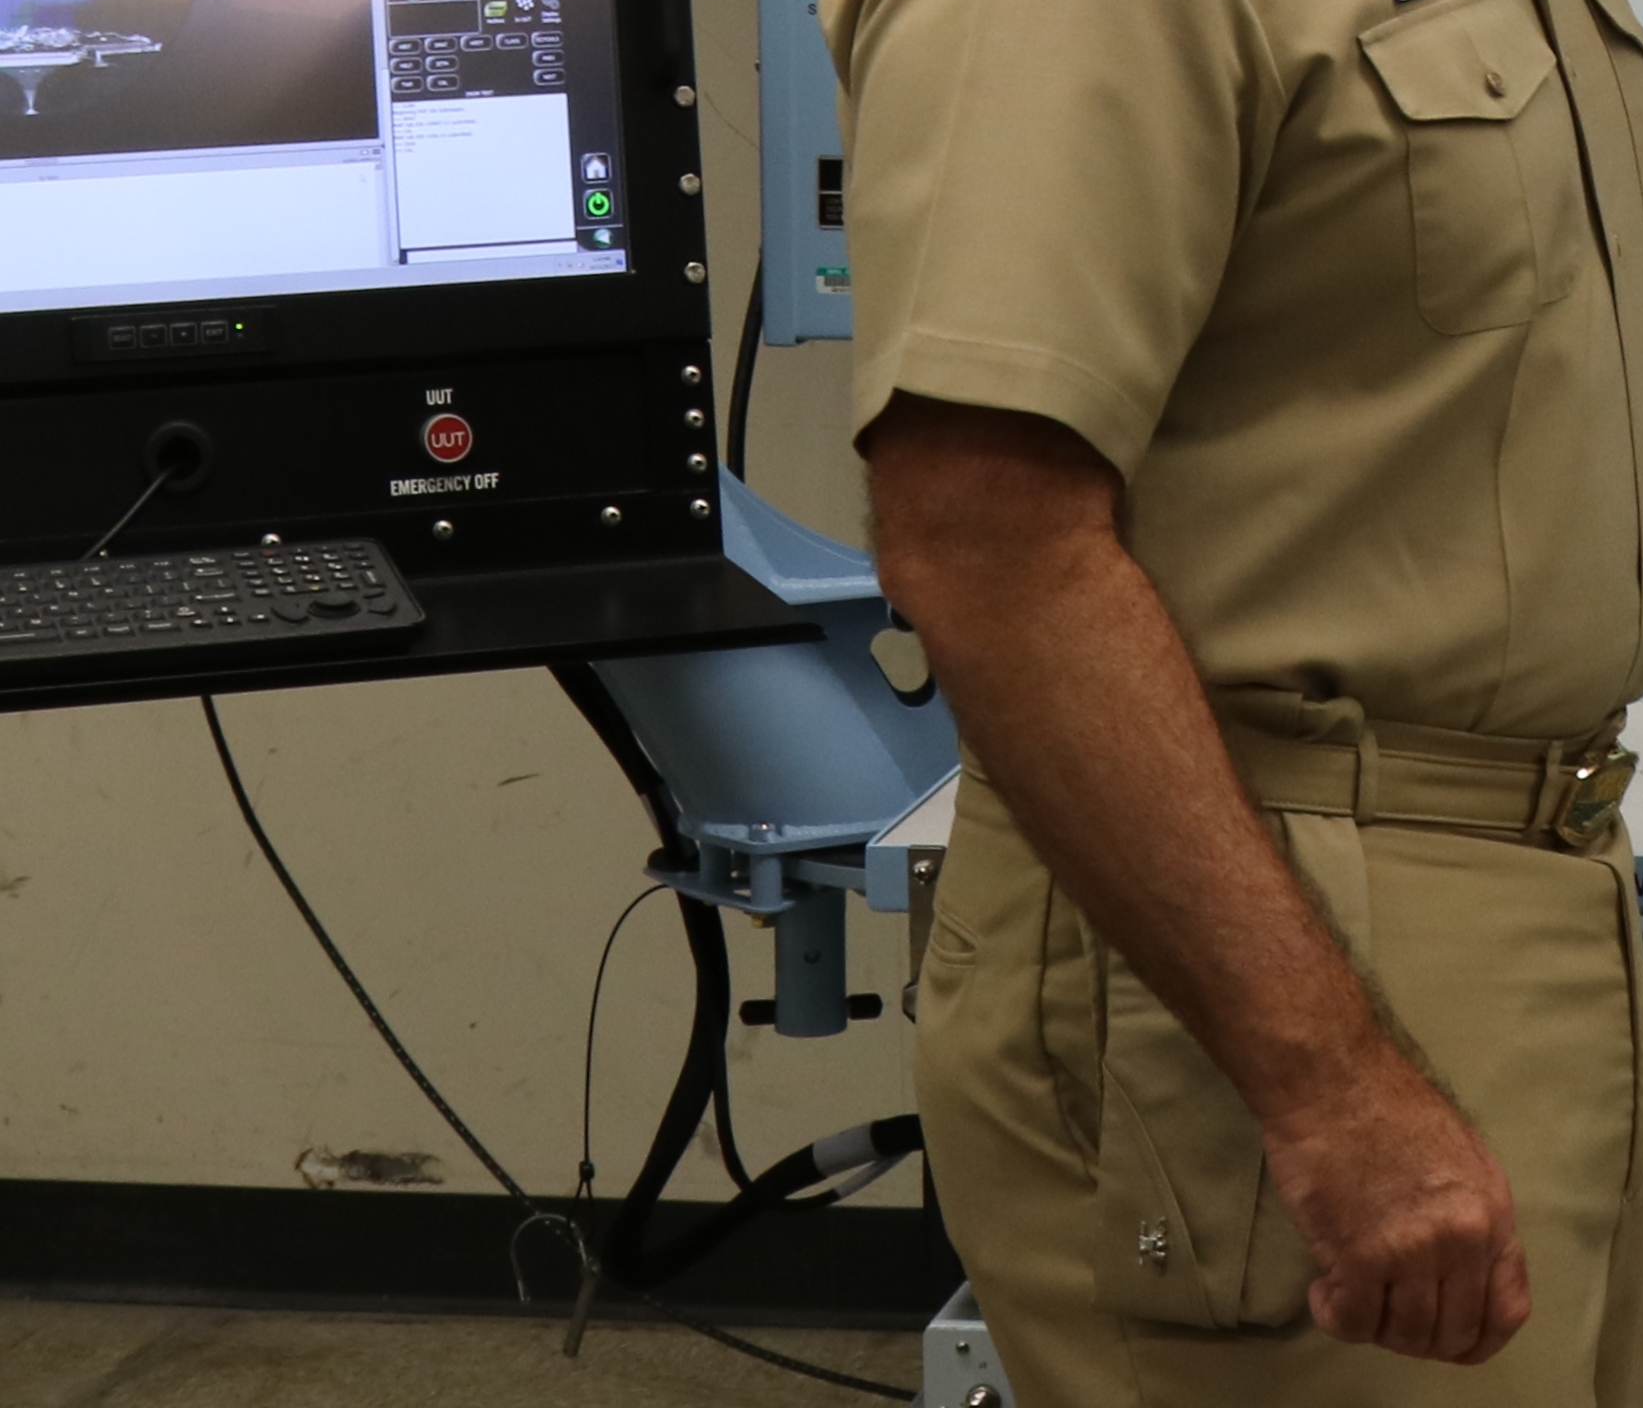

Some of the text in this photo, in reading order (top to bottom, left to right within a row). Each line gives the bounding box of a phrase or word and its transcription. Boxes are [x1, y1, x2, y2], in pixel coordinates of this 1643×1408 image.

[426, 388, 453, 405] UUT
[431, 432, 465, 448] UUT
[390, 473, 499, 496] EMERGENCY OFF
